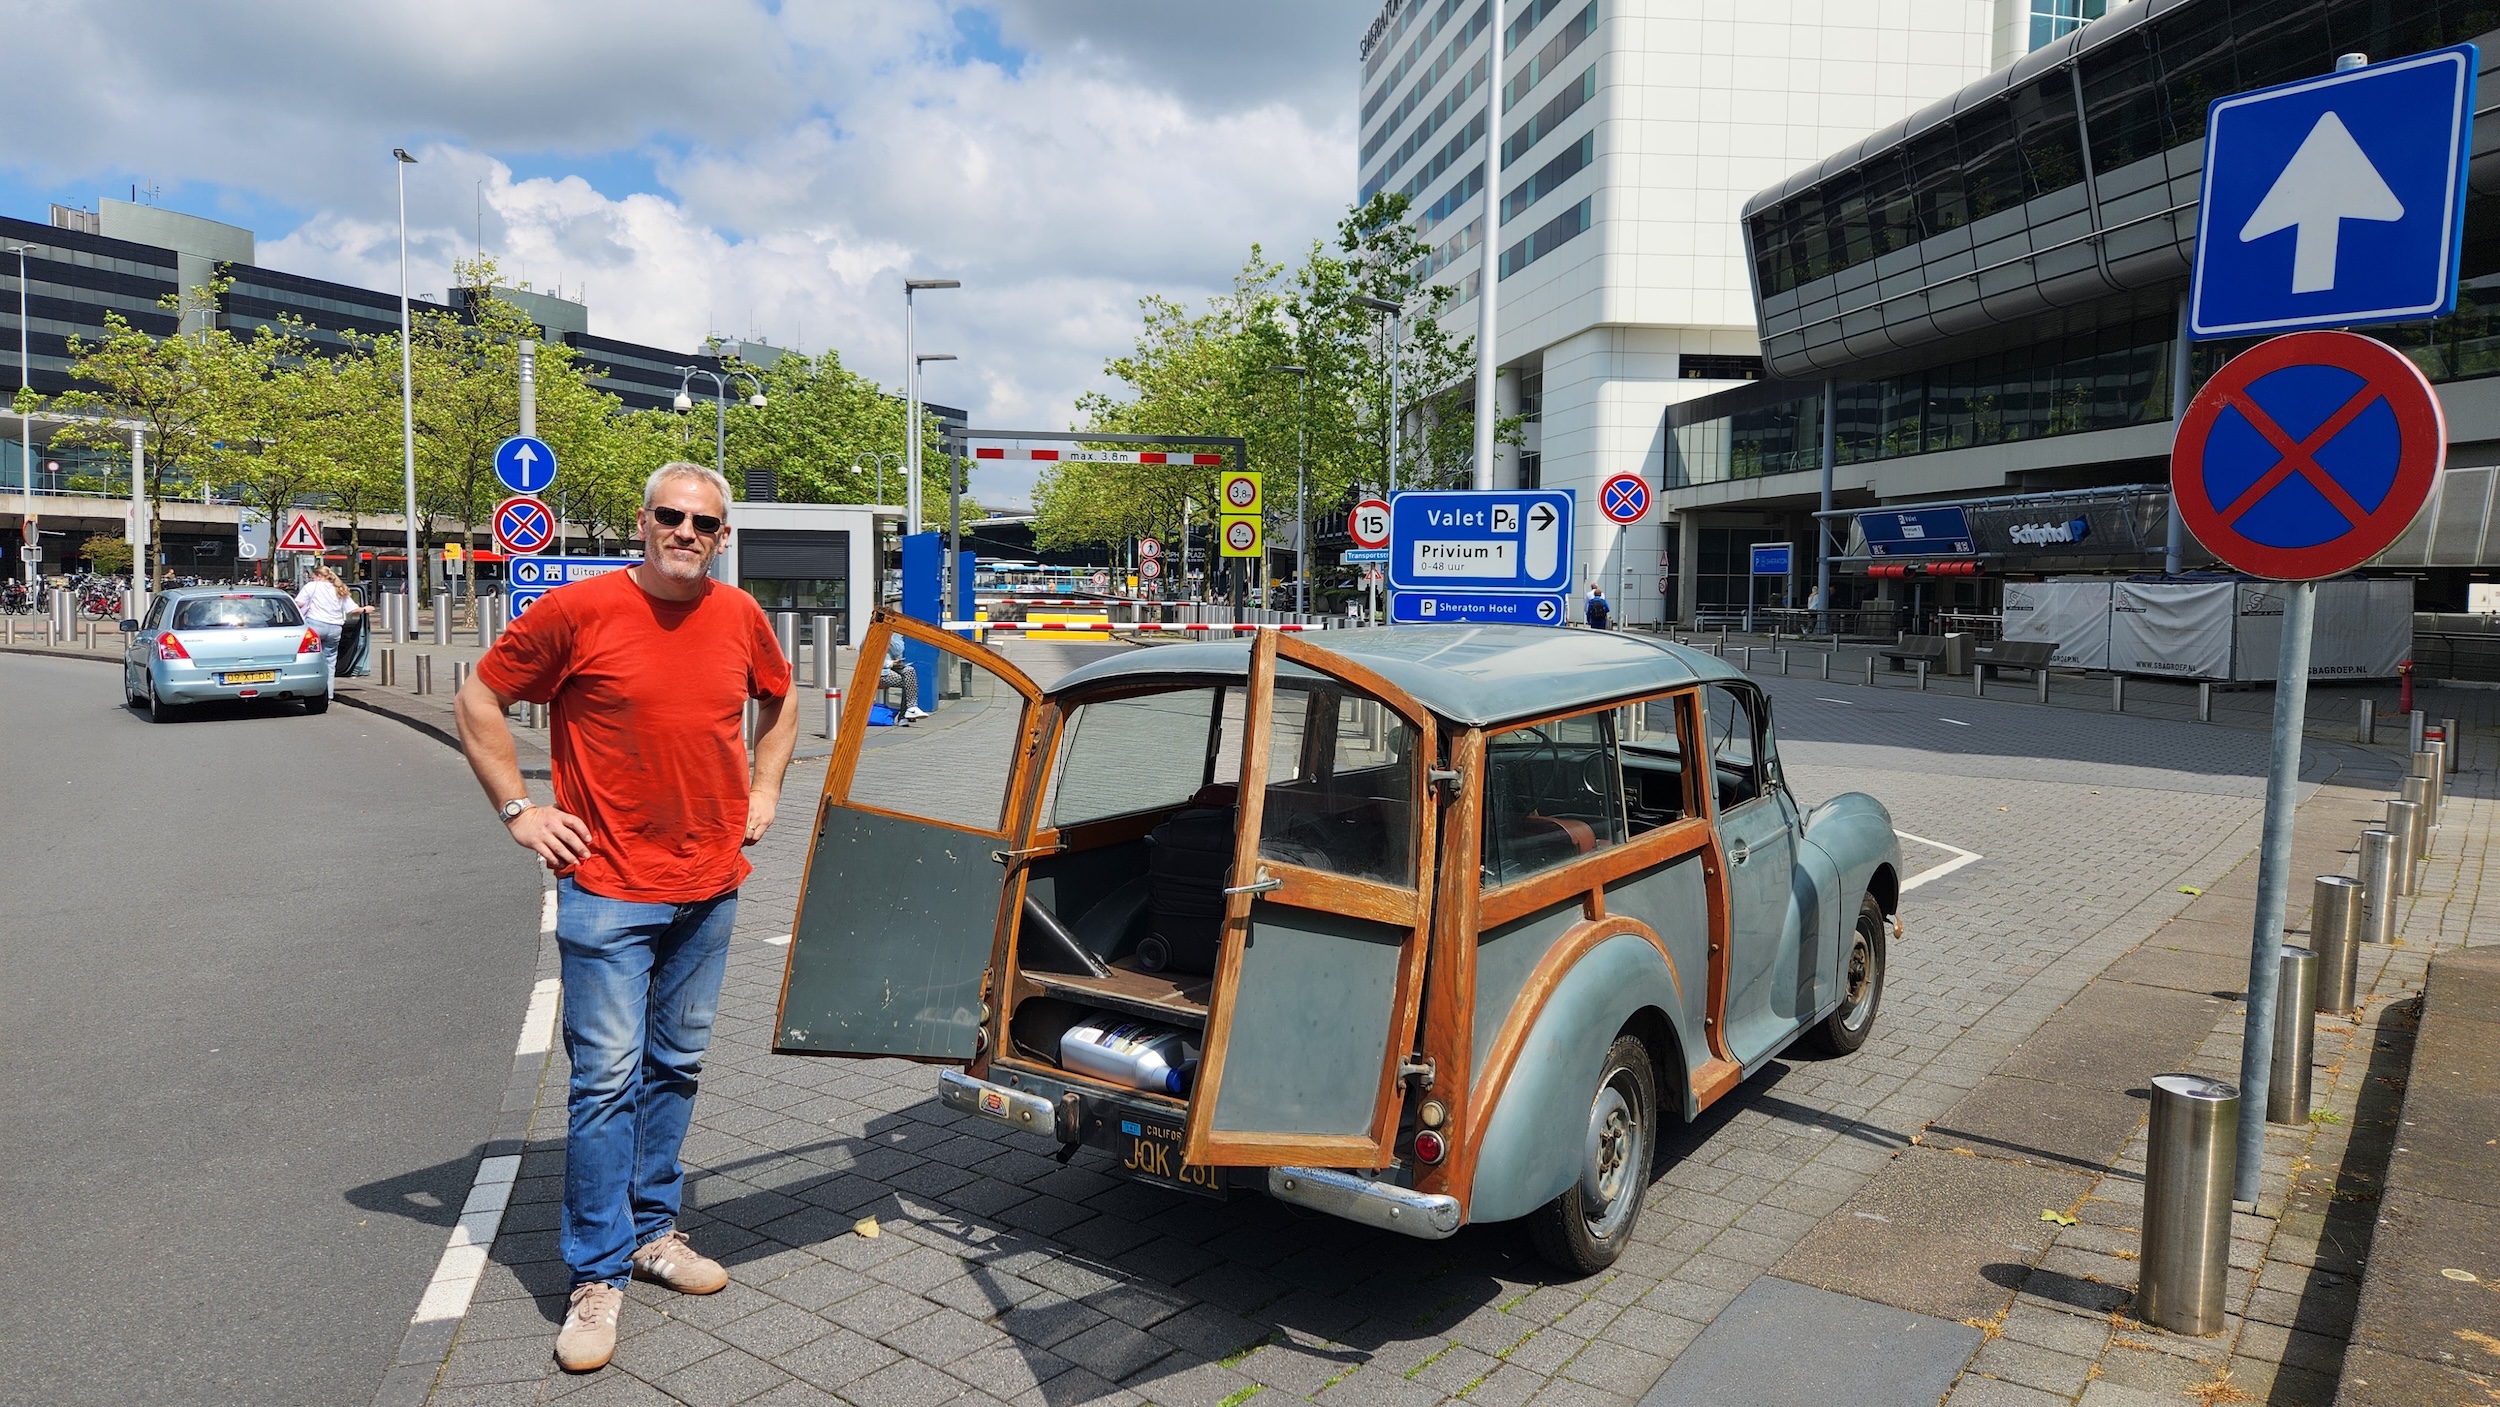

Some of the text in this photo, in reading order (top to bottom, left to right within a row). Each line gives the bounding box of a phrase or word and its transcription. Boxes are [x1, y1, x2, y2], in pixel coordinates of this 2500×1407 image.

[1070, 452, 1128, 462] max. 3,8m
[1427, 509, 1485, 527] Valet
[1362, 516, 1384, 534] 15
[2009, 521, 2073, 548] Schiphol
[1422, 544, 1504, 558] Privium 1
[572, 567, 614, 577] Uitgan
[1421, 562, 1445, 571] 0-48
[1424, 602, 1517, 614] P Sheraton Hotel
[2050, 655, 2080, 664] GROEP.NL
[2136, 660, 2197, 673] WWW.SBAGROEP.NL
[1146, 1125, 1182, 1141] CALIFOR
[1124, 1138, 1171, 1178] JQK
